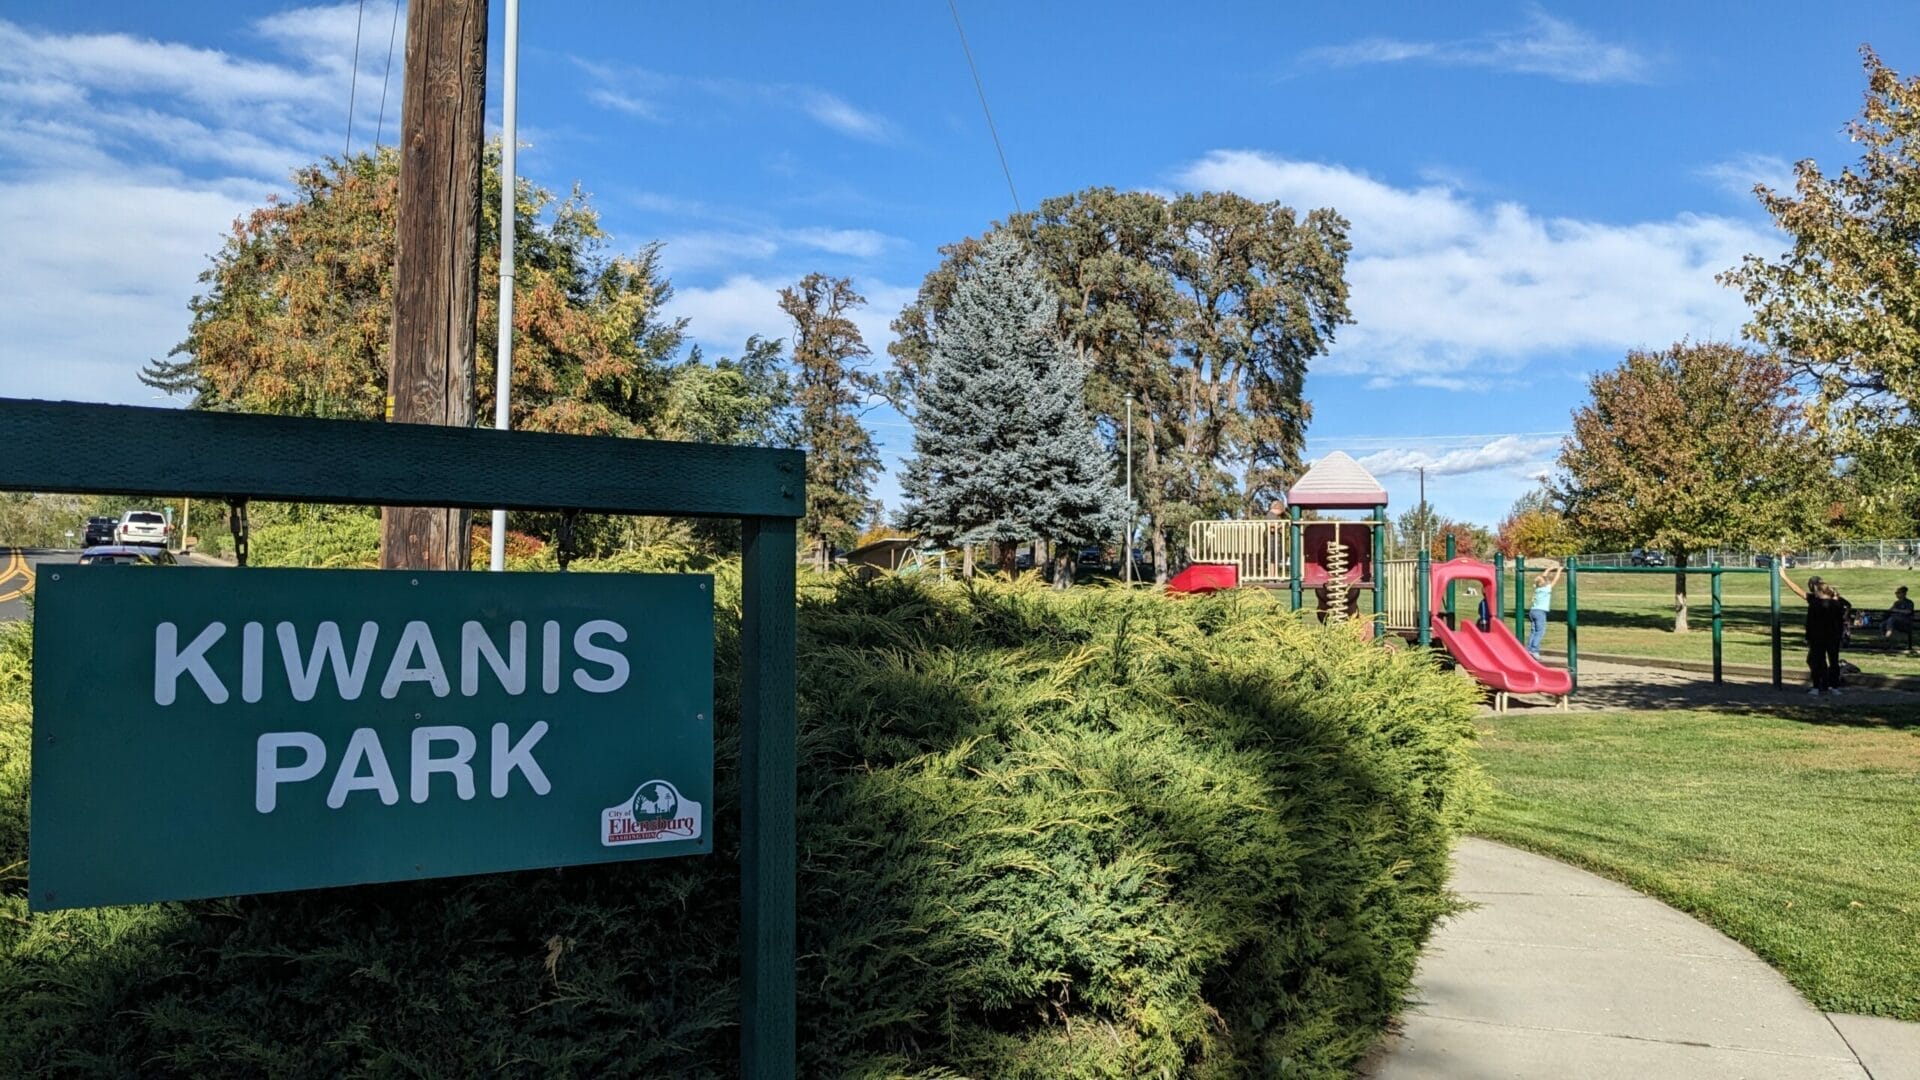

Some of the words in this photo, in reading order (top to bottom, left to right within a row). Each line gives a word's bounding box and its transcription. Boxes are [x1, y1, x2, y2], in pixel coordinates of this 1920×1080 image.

[154, 619, 630, 706] KIWANIS
[256, 720, 552, 814] PARK
[608, 810, 622, 819] City
[624, 809, 631, 817] of
[609, 816, 694, 836] Ellensburg
